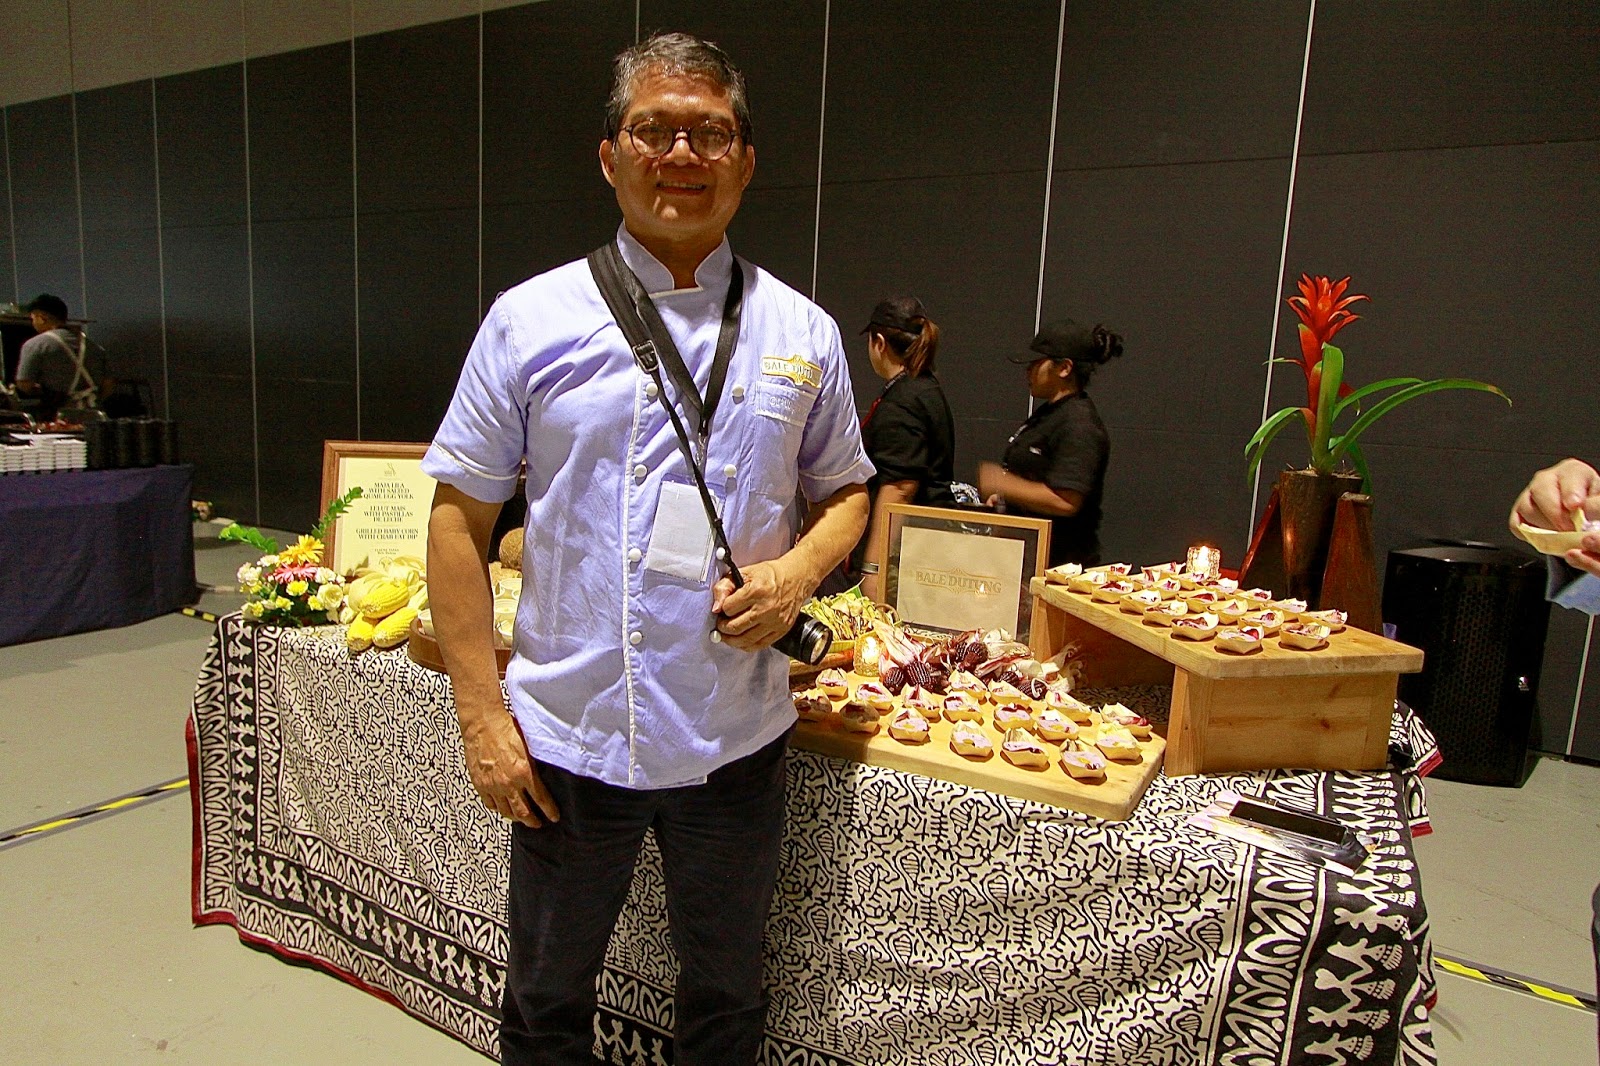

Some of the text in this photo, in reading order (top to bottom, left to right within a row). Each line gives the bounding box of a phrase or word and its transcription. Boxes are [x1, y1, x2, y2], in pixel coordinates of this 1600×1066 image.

[763, 360, 790, 373] BALE
[915, 571, 1002, 594] BALE DUTUNG
